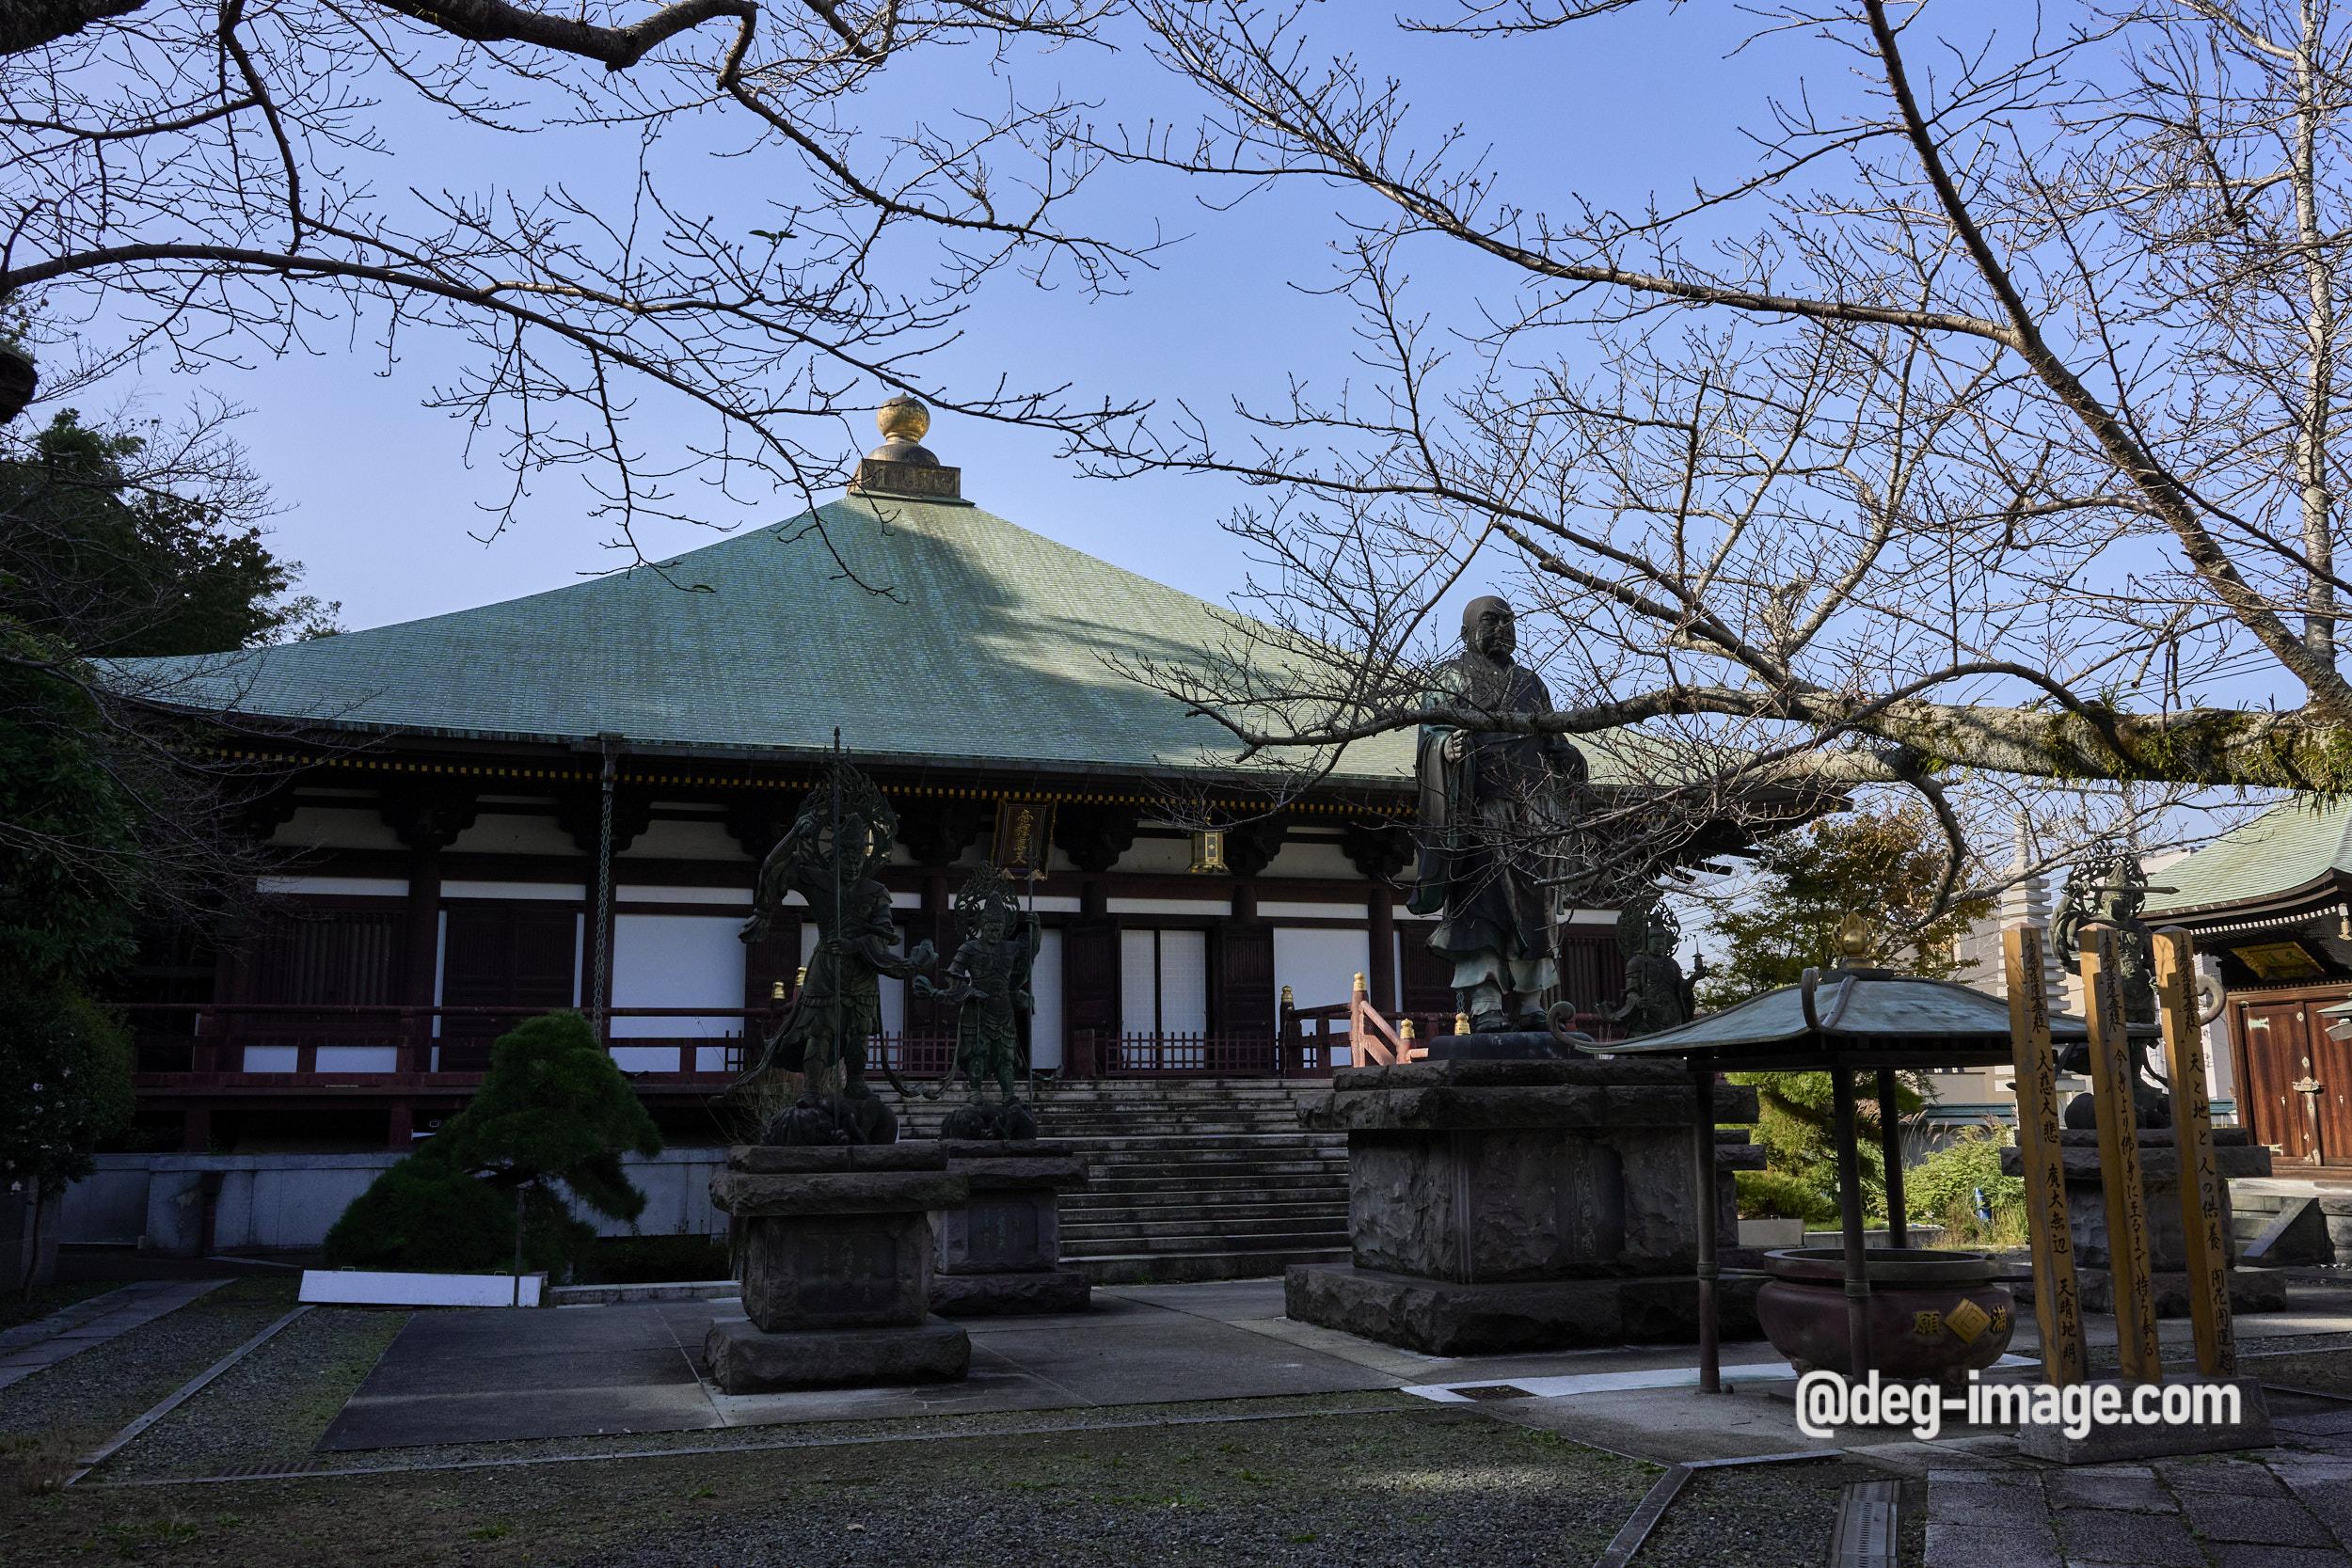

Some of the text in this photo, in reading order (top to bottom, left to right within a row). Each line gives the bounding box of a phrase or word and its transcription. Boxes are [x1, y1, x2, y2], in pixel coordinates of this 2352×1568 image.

[2036, 1050, 2058, 1144] 大慈大悲
[2058, 1278, 2077, 1364] 天晴地明
